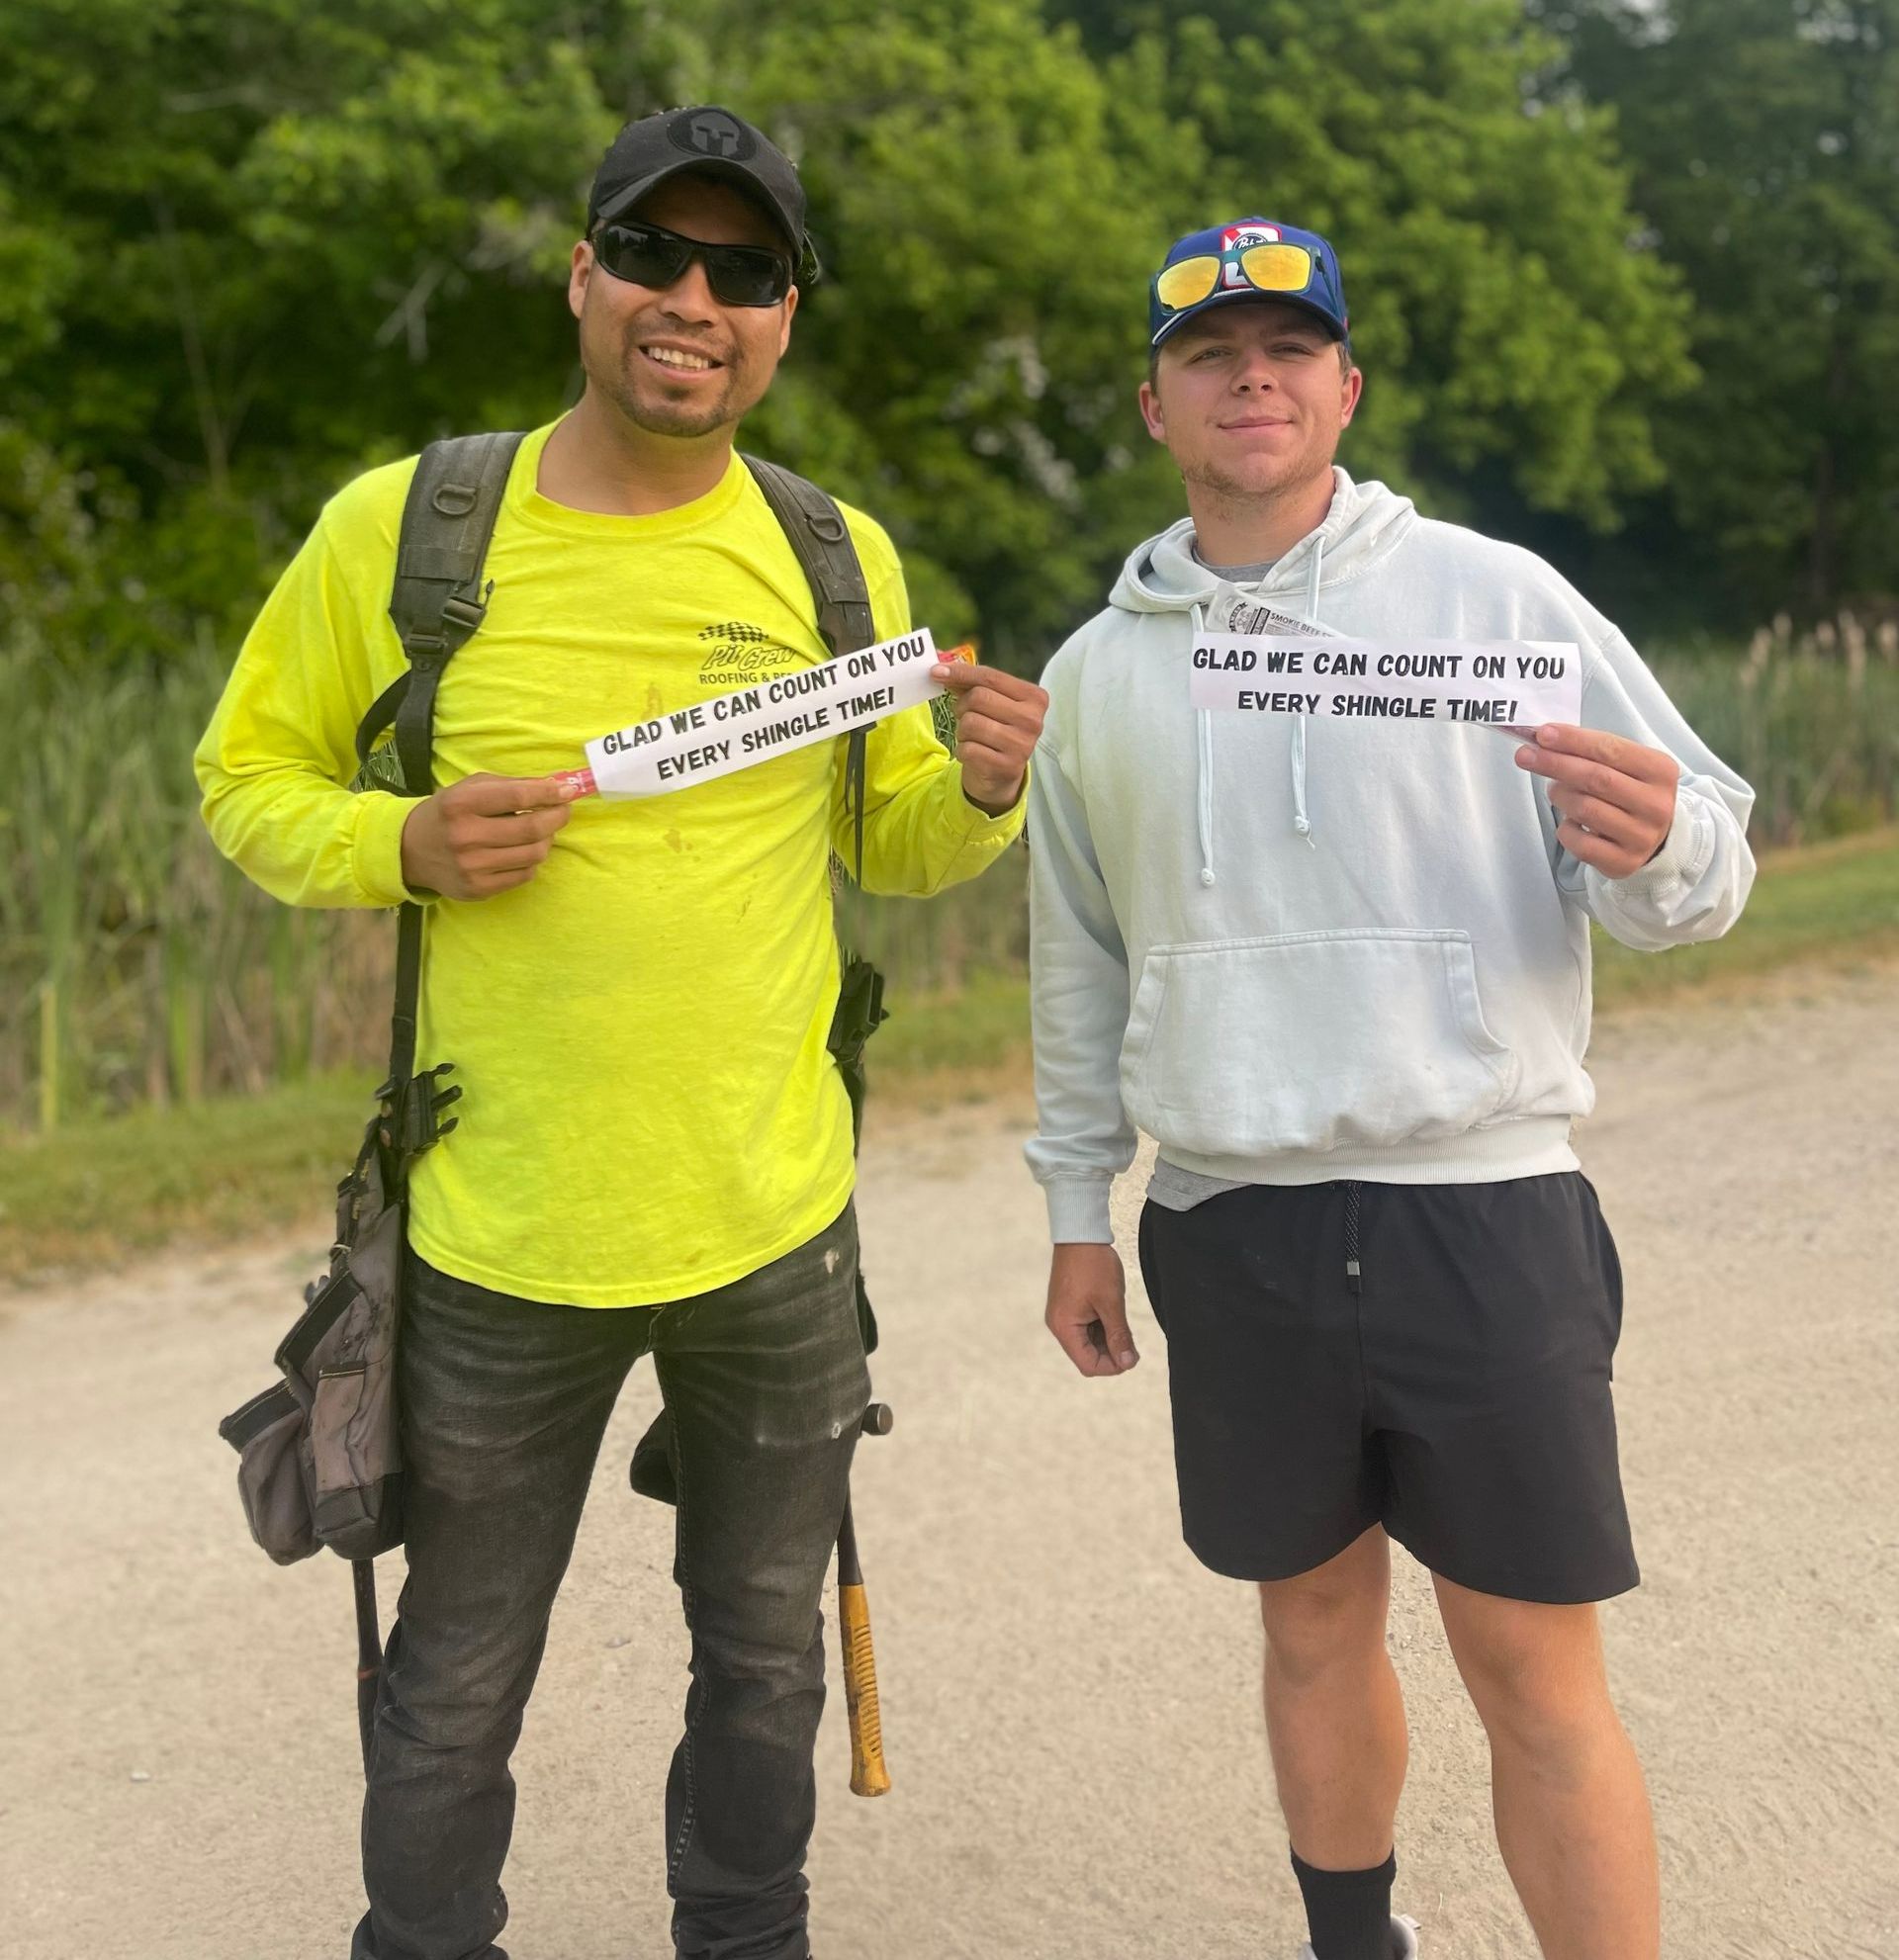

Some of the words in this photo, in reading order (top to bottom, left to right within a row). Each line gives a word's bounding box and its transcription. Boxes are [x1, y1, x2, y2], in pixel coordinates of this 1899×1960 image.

[1270, 612, 1301, 629] SMOKIE
[701, 645, 745, 670] Pit
[738, 647, 796, 671] Crew
[1193, 648, 1257, 671] GLAD
[1267, 652, 1304, 674] WE
[1312, 653, 1367, 676] CAN
[1377, 654, 1463, 678] COUNT
[1473, 656, 1505, 679] ON
[1516, 657, 1565, 680] YOU
[699, 672, 758, 684] ROOFING
[762, 672, 770, 682] &
[603, 720, 663, 755] GLAD
[670, 707, 706, 735] WE
[714, 690, 763, 721] CAN
[769, 665, 838, 704] COUNT
[848, 653, 876, 678] ON
[882, 636, 925, 667] YOU
[1237, 690, 1320, 715] EVERY
[1331, 694, 1436, 720] SHINGLE
[1447, 698, 1518, 723] TIME!
[657, 740, 730, 780] EVERY
[742, 707, 830, 753] SHINGLE
[837, 686, 894, 721] TIME!
